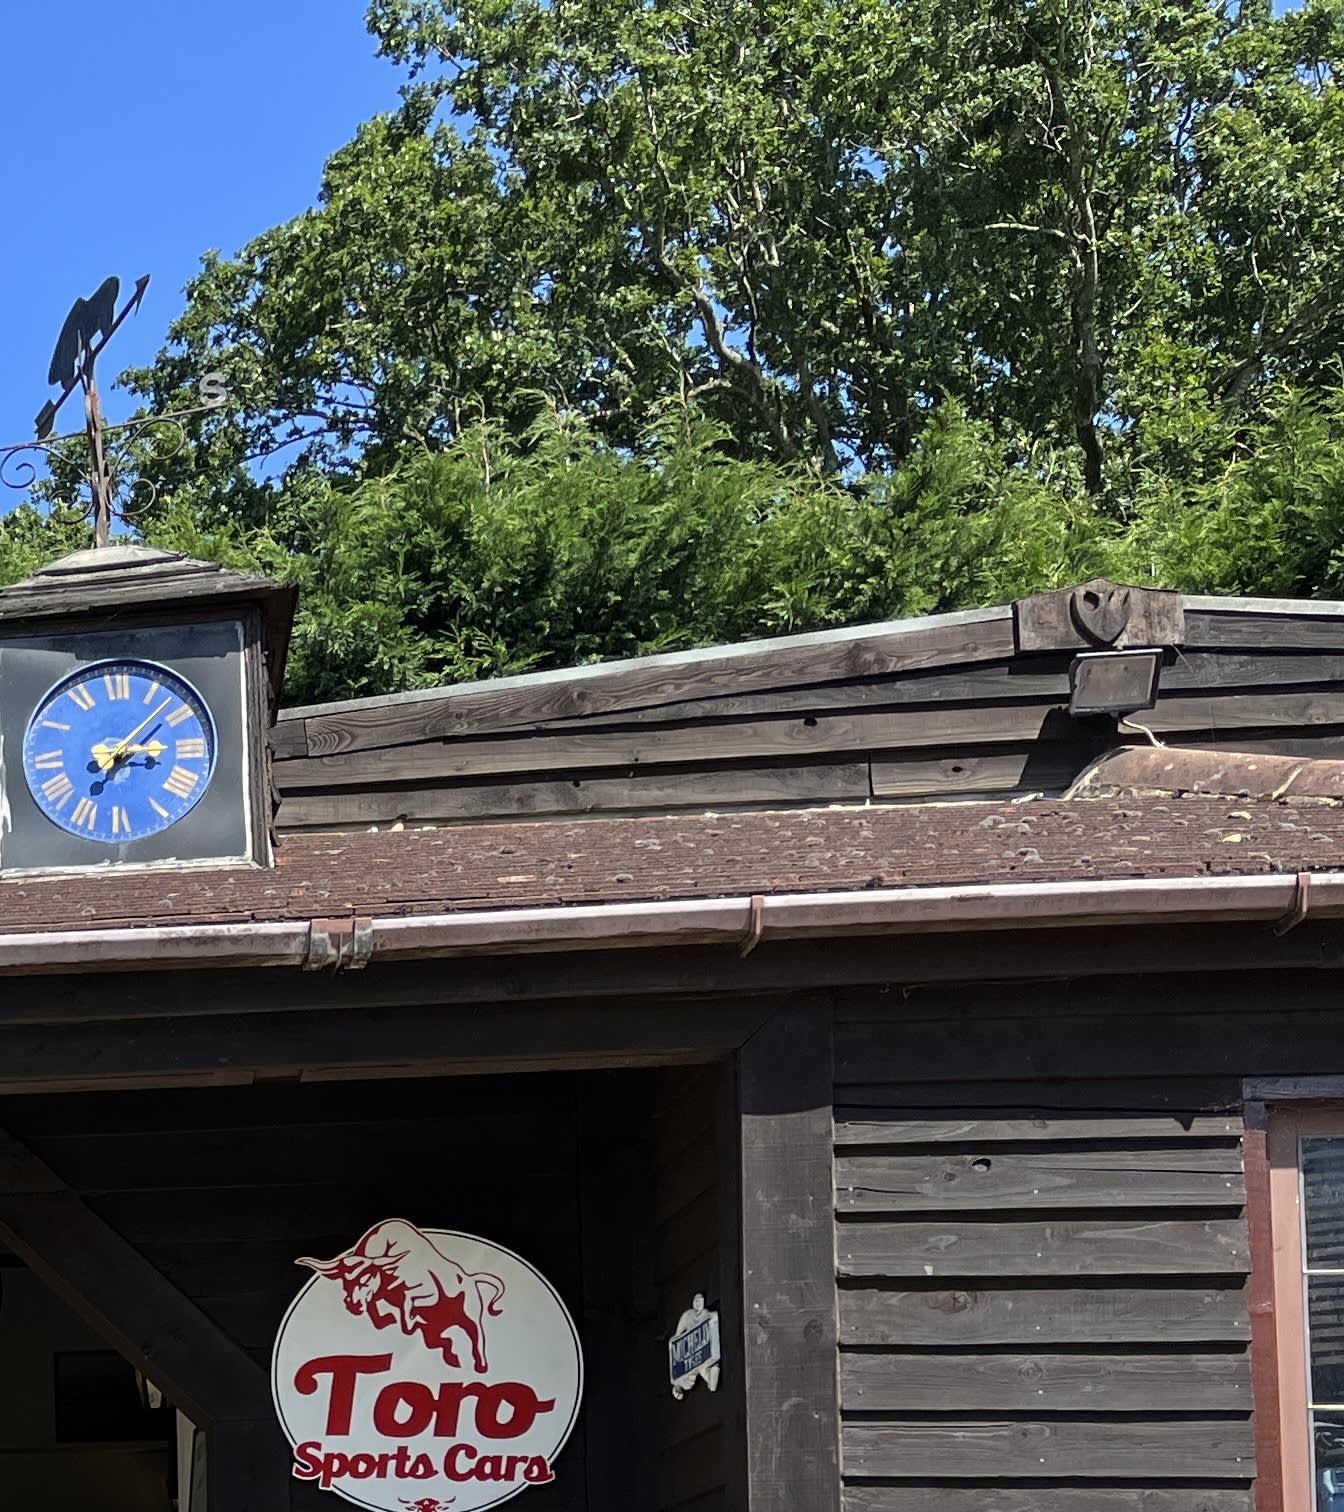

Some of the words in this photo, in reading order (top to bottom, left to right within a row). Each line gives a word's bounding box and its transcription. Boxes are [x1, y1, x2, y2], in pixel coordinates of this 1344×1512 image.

[295, 1353, 556, 1438] Toro
[295, 1441, 437, 1488] Sports
[444, 1443, 553, 1483] Cars
